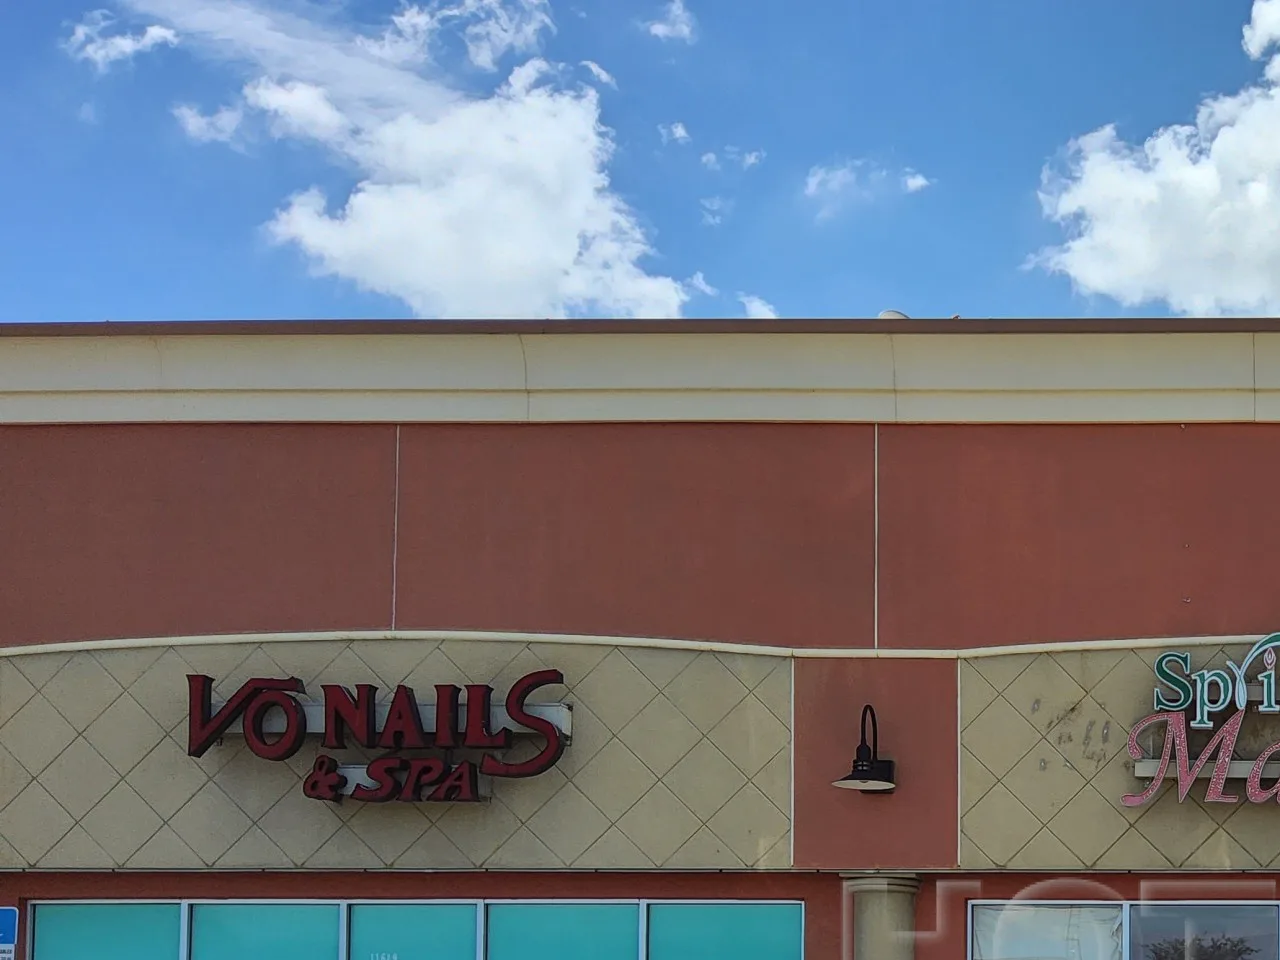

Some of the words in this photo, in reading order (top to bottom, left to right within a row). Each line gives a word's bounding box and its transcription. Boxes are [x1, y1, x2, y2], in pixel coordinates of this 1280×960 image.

[186, 673, 306, 761] VO
[321, 668, 567, 779] NAILS
[303, 755, 345, 803] &
[353, 756, 481, 803] SPA
